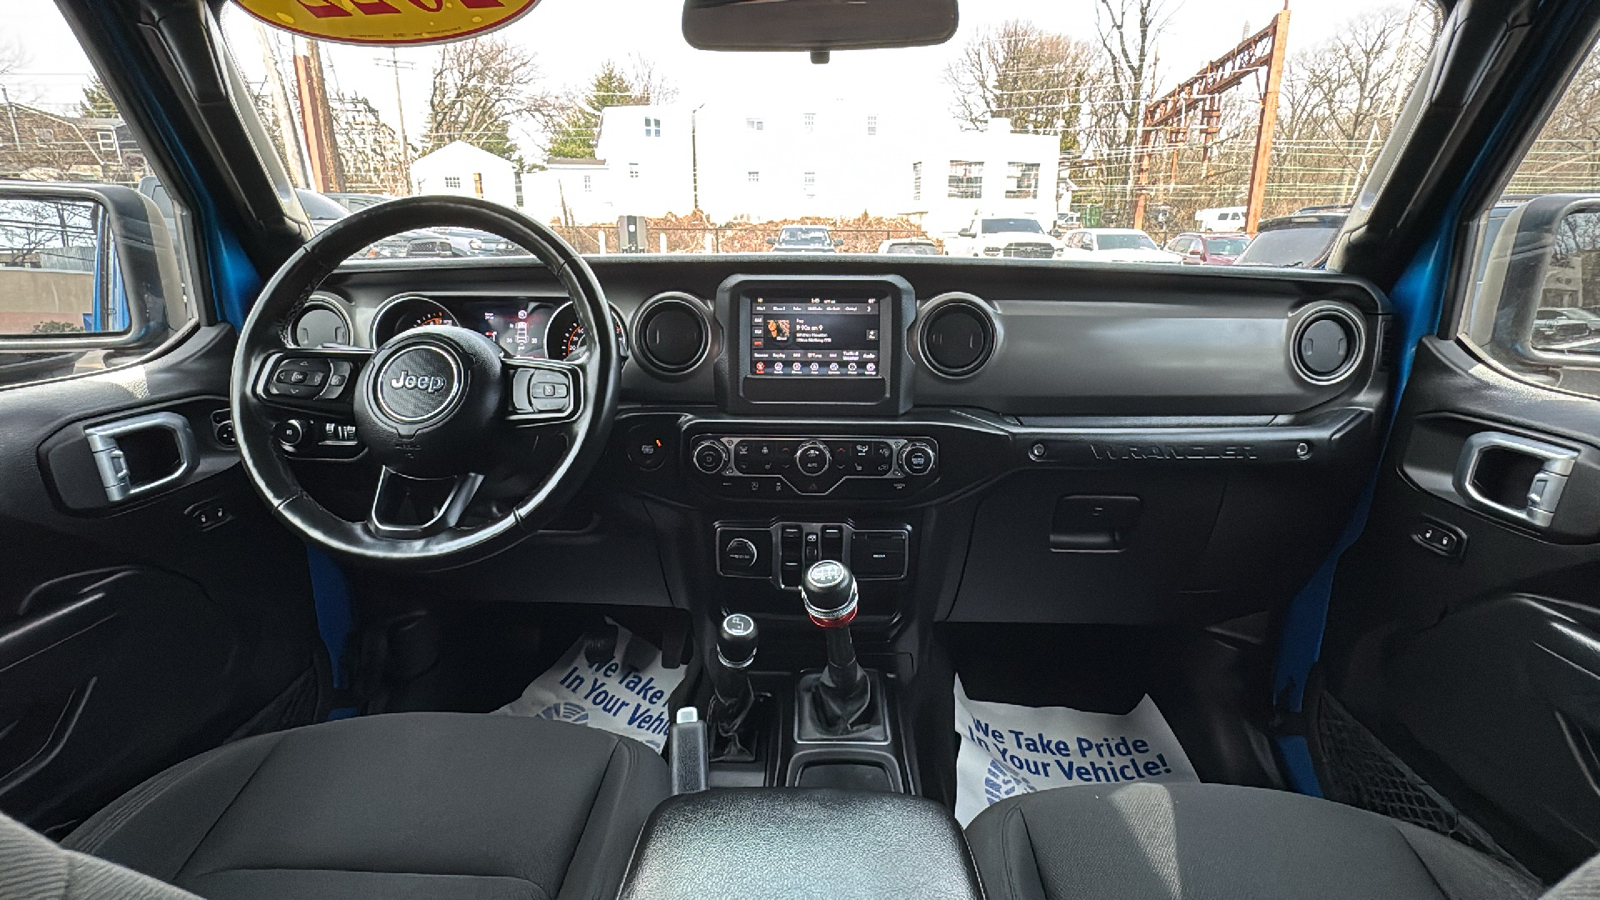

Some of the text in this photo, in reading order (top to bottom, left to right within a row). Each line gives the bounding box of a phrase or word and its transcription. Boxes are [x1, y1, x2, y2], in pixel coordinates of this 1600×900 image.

[391, 371, 447, 394] Jeep
[1090, 444, 1257, 460] WRANGLER
[559, 666, 586, 694] In
[583, 678, 630, 717] Your
[618, 665, 665, 705] Take
[968, 725, 1172, 783] In Your Vehicle!
[972, 718, 1149, 759] We Take Pride
